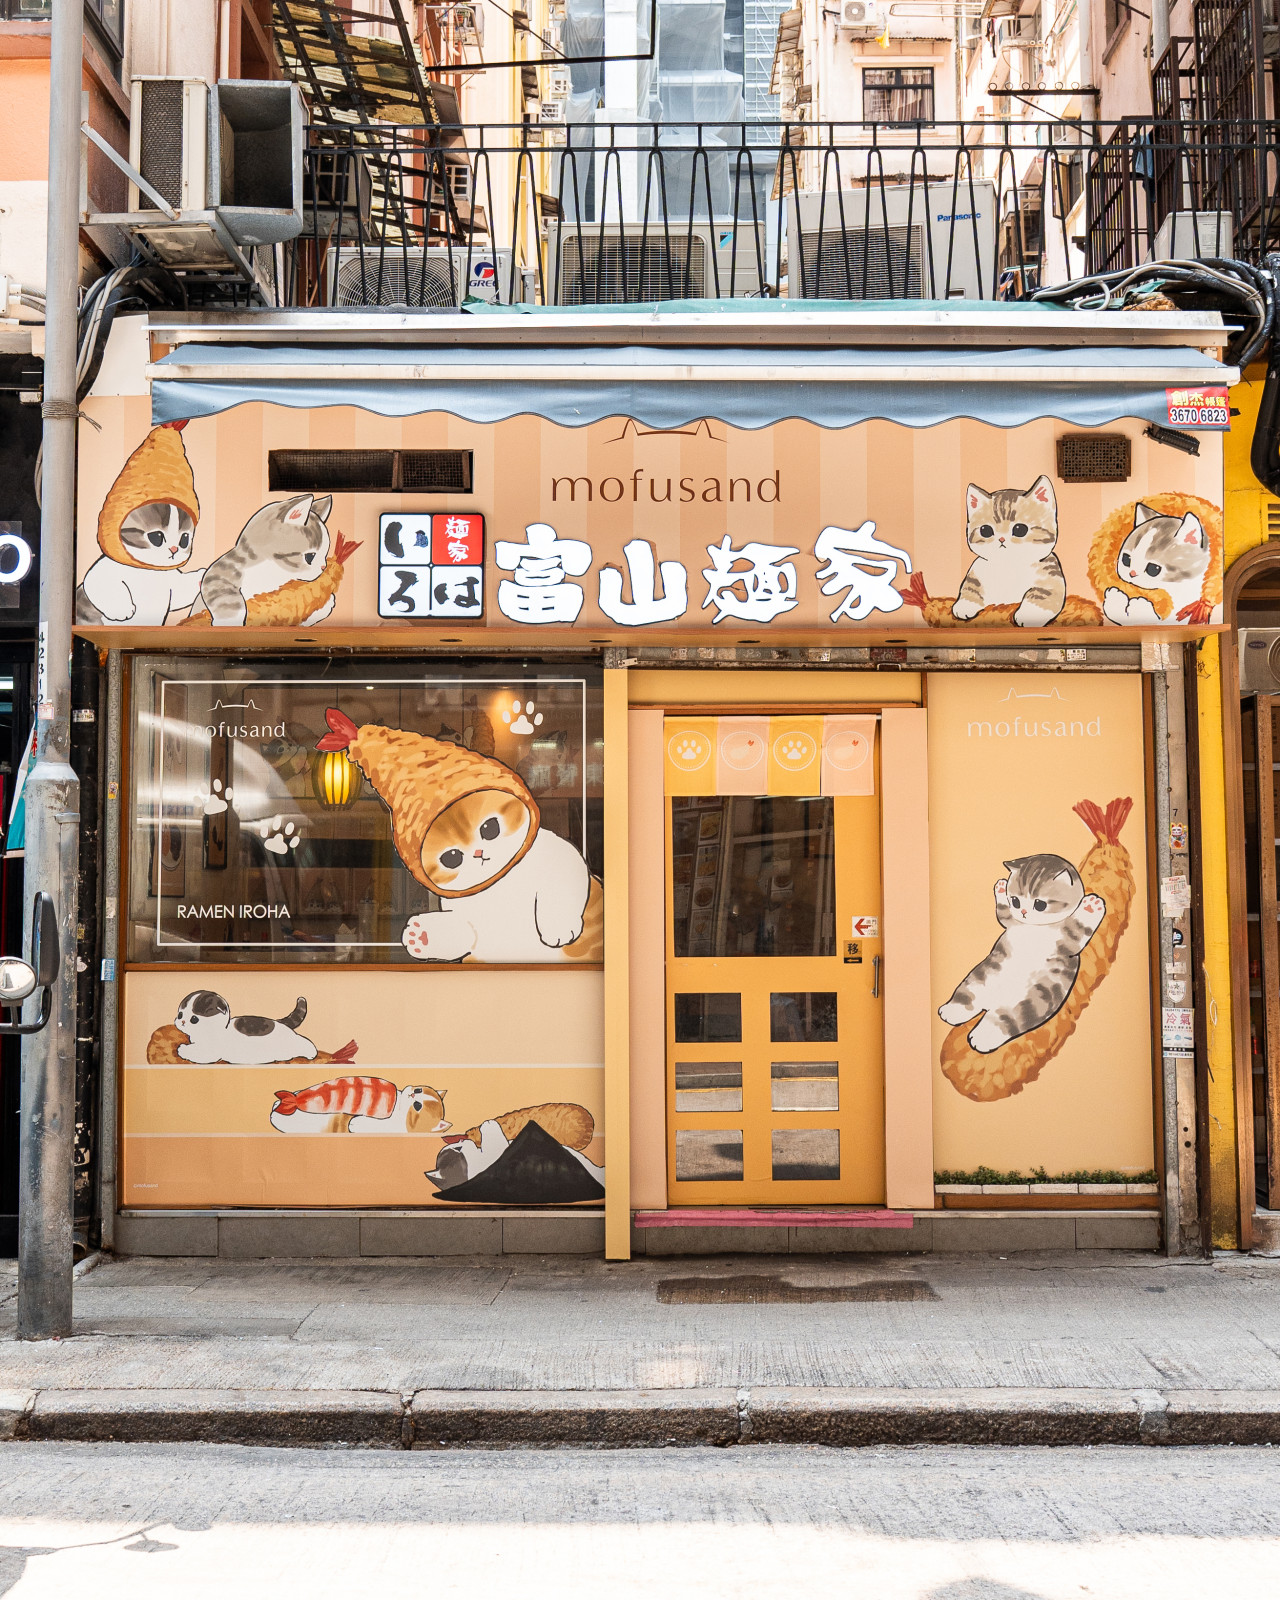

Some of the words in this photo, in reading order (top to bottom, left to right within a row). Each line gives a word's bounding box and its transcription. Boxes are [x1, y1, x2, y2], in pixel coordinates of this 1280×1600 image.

[1171, 408, 1197, 422] 3670
[1200, 408, 1227, 423] 6823
[551, 468, 782, 503] mofusand
[967, 716, 1101, 737] mofusand
[1172, 808, 1178, 817] 7
[177, 904, 235, 919] RAMEN
[239, 904, 291, 919] IROHA
[847, 942, 859, 955] 移
[1166, 1012, 1191, 1026] 冷氣
